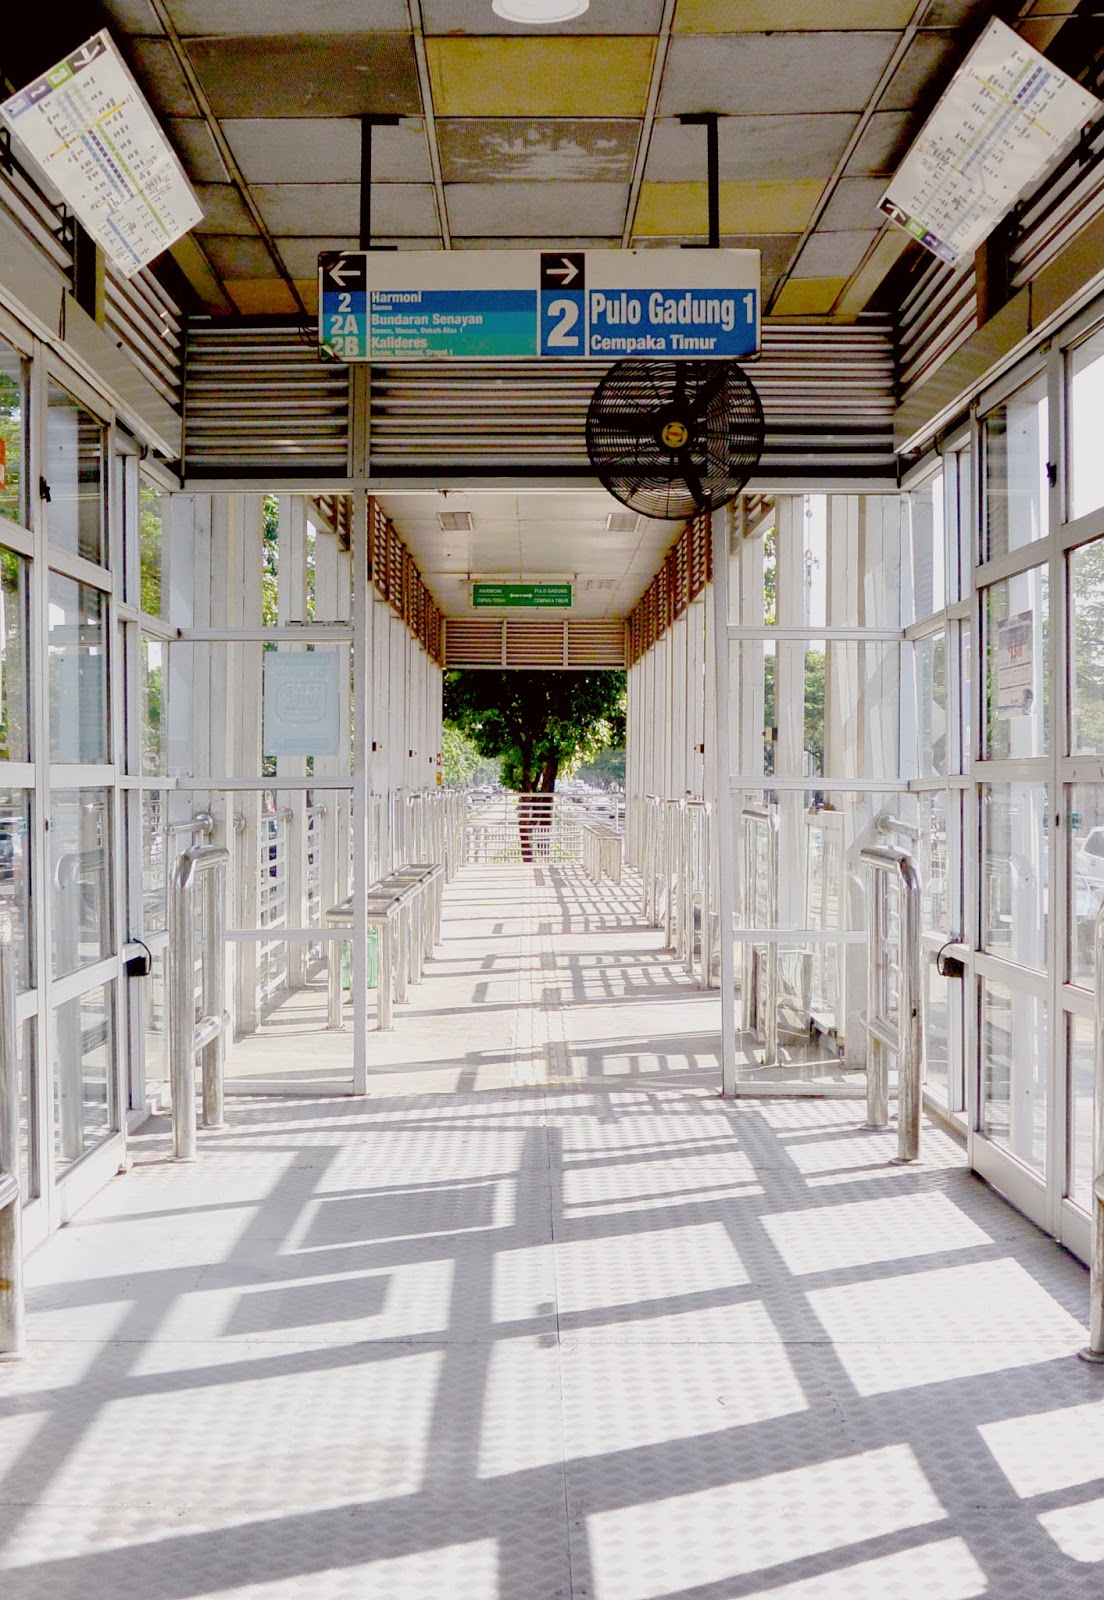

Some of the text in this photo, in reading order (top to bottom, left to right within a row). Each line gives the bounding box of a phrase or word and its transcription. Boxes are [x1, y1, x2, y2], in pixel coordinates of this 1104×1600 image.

[30, 85, 46, 98] 2
[338, 293, 351, 312] 2
[372, 291, 422, 303] Harmoni
[372, 313, 483, 327] Bundaran Senayan
[591, 291, 754, 332] Pulo Gadung 1
[330, 314, 359, 334] 2A
[547, 299, 579, 347] 2
[331, 336, 360, 356] 2B
[372, 335, 427, 348] Kalideres
[591, 334, 718, 353] Cempaka Timur
